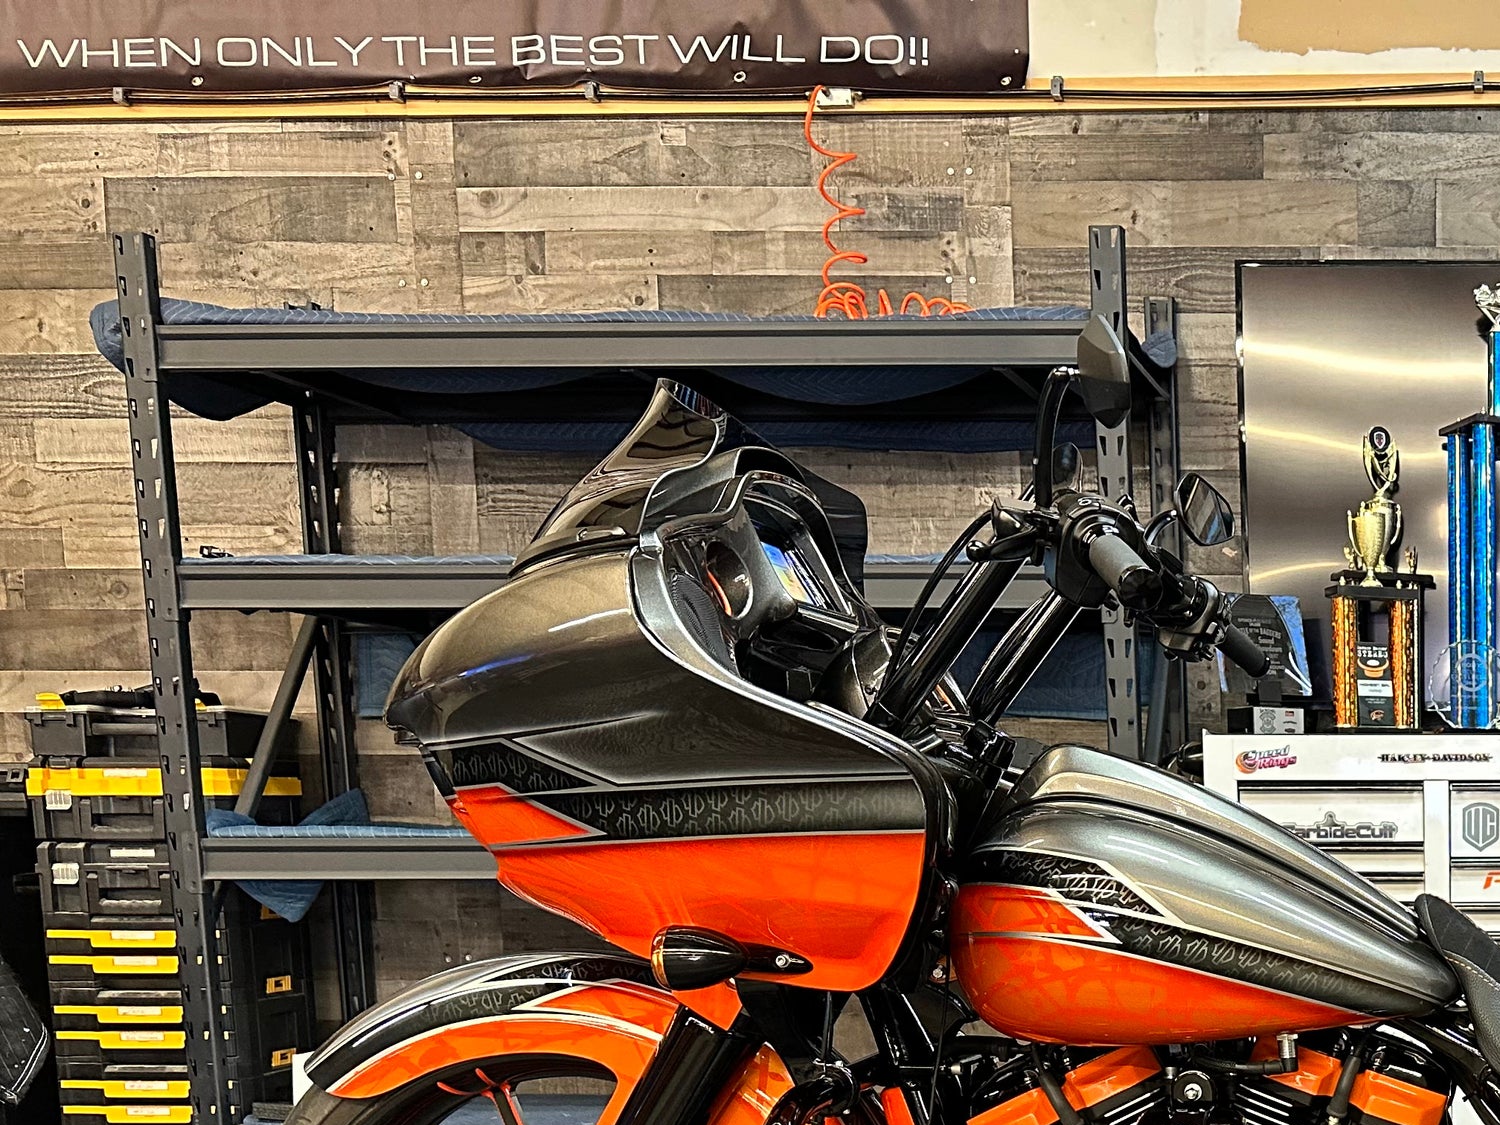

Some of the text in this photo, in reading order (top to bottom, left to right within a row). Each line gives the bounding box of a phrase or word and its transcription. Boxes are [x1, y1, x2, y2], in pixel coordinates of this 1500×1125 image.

[17, 34, 930, 68] WHEN ONLY THE BEST WILL DO!!
